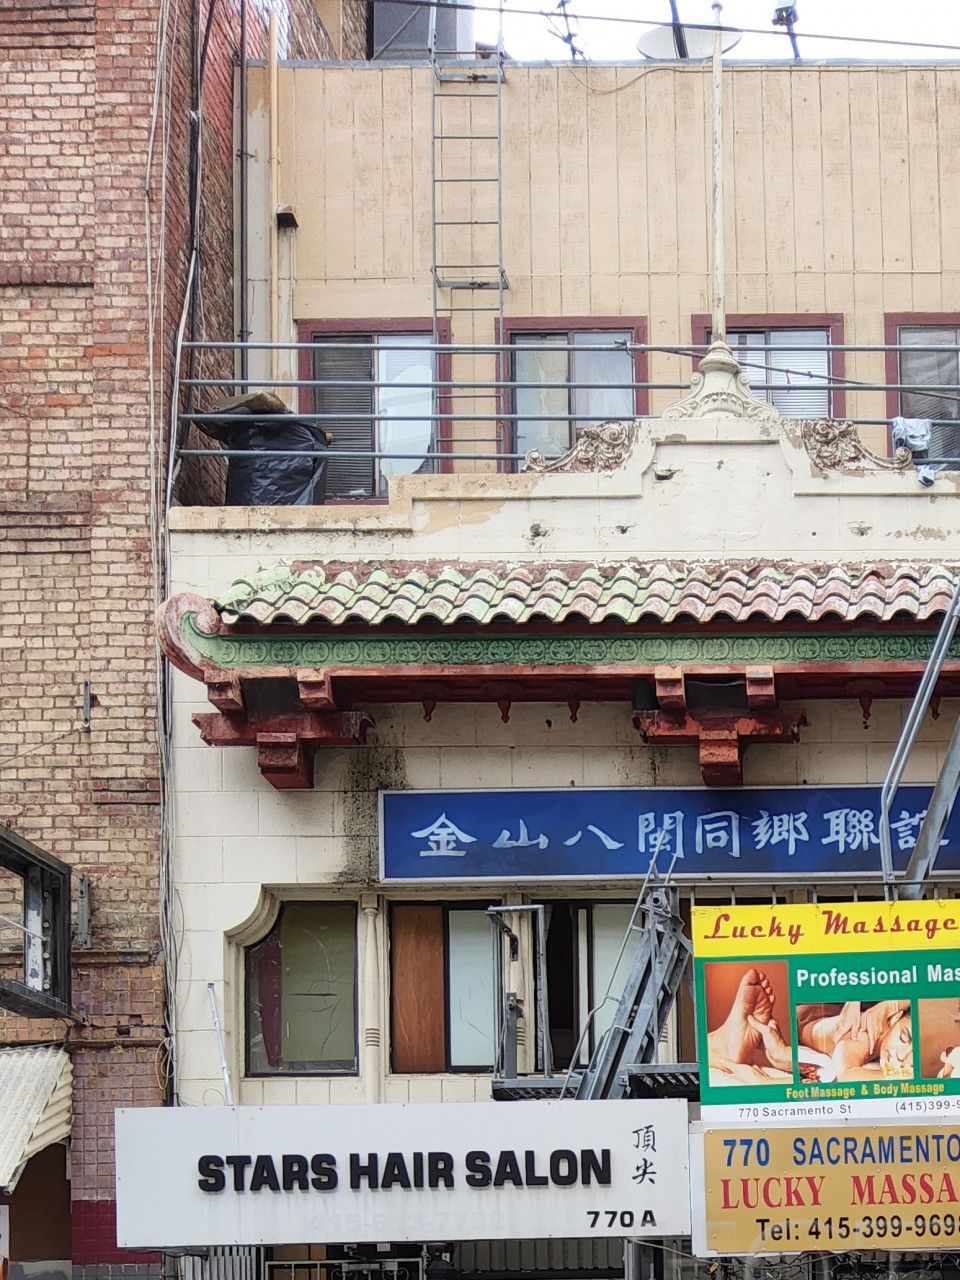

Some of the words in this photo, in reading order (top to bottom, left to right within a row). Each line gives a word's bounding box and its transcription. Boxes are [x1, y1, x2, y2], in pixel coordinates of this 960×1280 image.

[703, 913, 805, 945] Lucky
[820, 910, 960, 939] Massage
[796, 965, 918, 988] Professional
[785, 1087, 810, 1099] Foot
[811, 1085, 857, 1099] Massage
[860, 1085, 869, 1096] &
[873, 1083, 900, 1097] Body
[900, 1082, 946, 1096] Massage
[738, 1107, 760, 1118] 770
[762, 1105, 834, 1117] Sacramento
[839, 1104, 853, 1115] St
[631, 1123, 658, 1187] 頂尖
[722, 1138, 771, 1167] 770
[198, 1153, 338, 1193] STARS
[350, 1152, 455, 1190] HAIR
[465, 1148, 612, 1188] SALON
[720, 1175, 826, 1210] LUCKY
[587, 1209, 634, 1228] 770
[640, 1209, 657, 1227] A
[755, 1217, 800, 1241] Tel:
